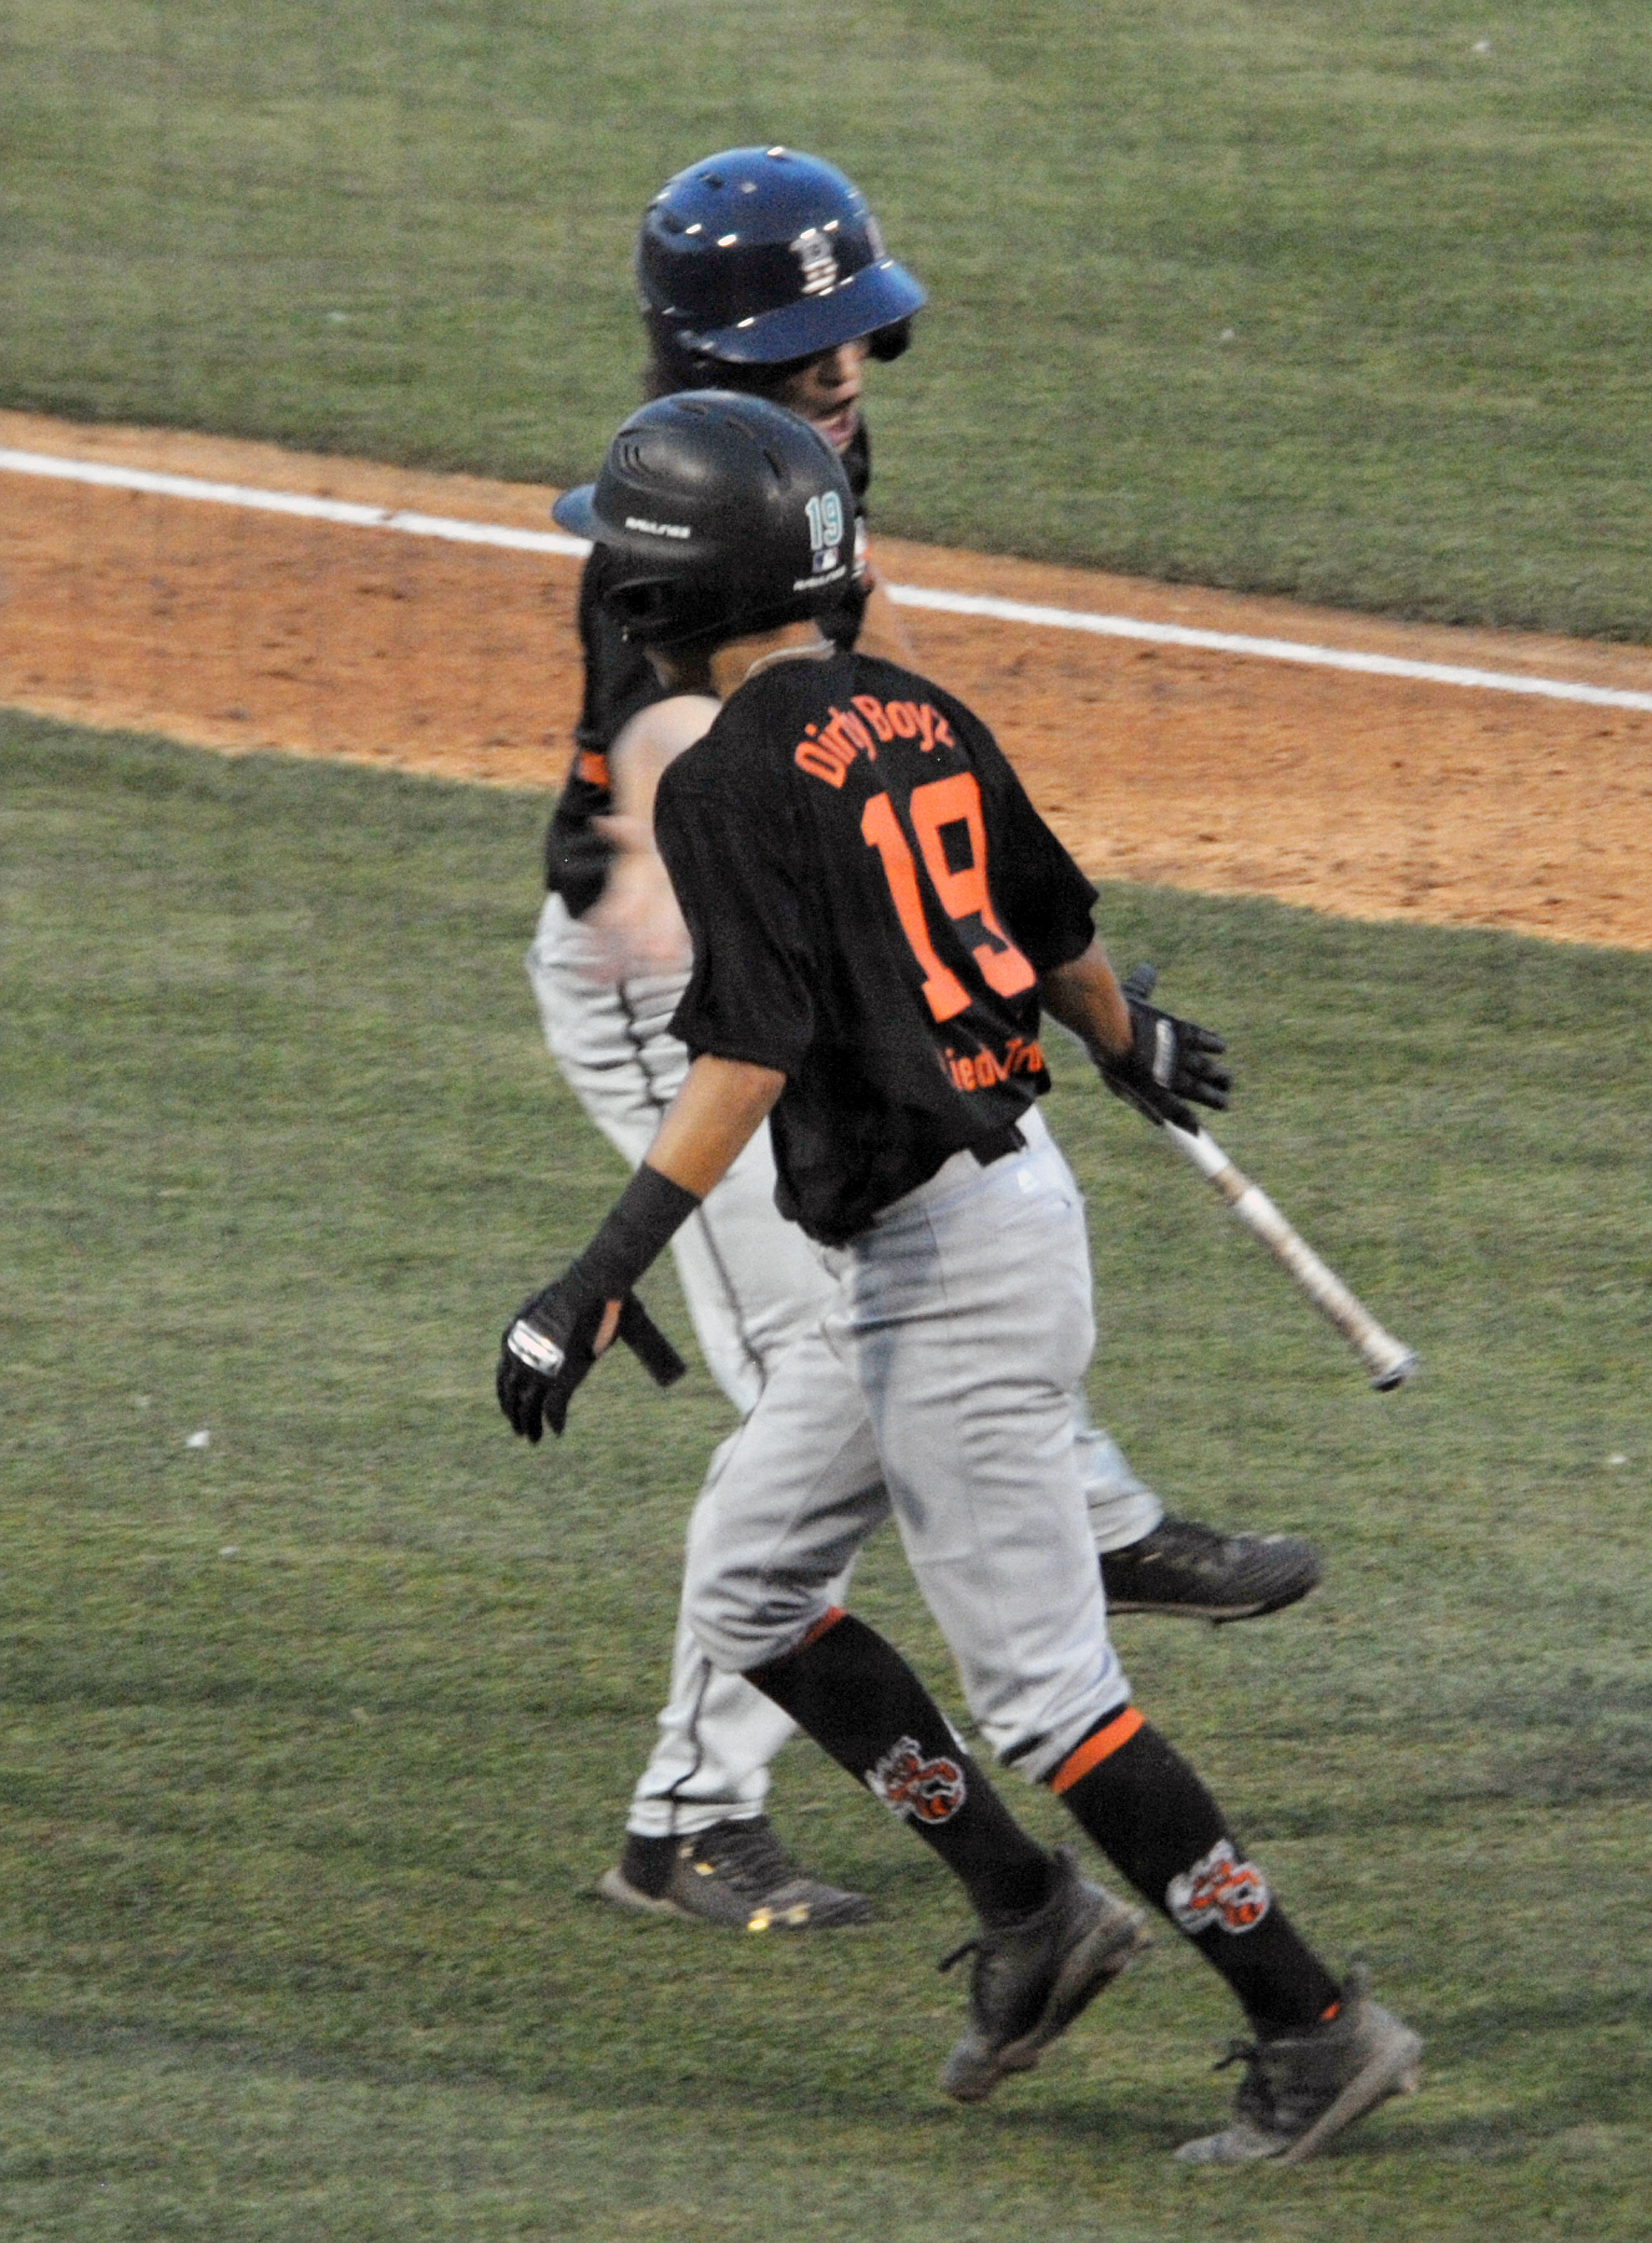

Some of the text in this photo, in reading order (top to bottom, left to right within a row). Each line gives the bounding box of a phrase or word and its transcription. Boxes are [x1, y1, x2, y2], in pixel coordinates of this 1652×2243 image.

[805, 491, 844, 551] 19
[794, 706, 878, 789] Dirty
[860, 771, 1037, 1024] 19
